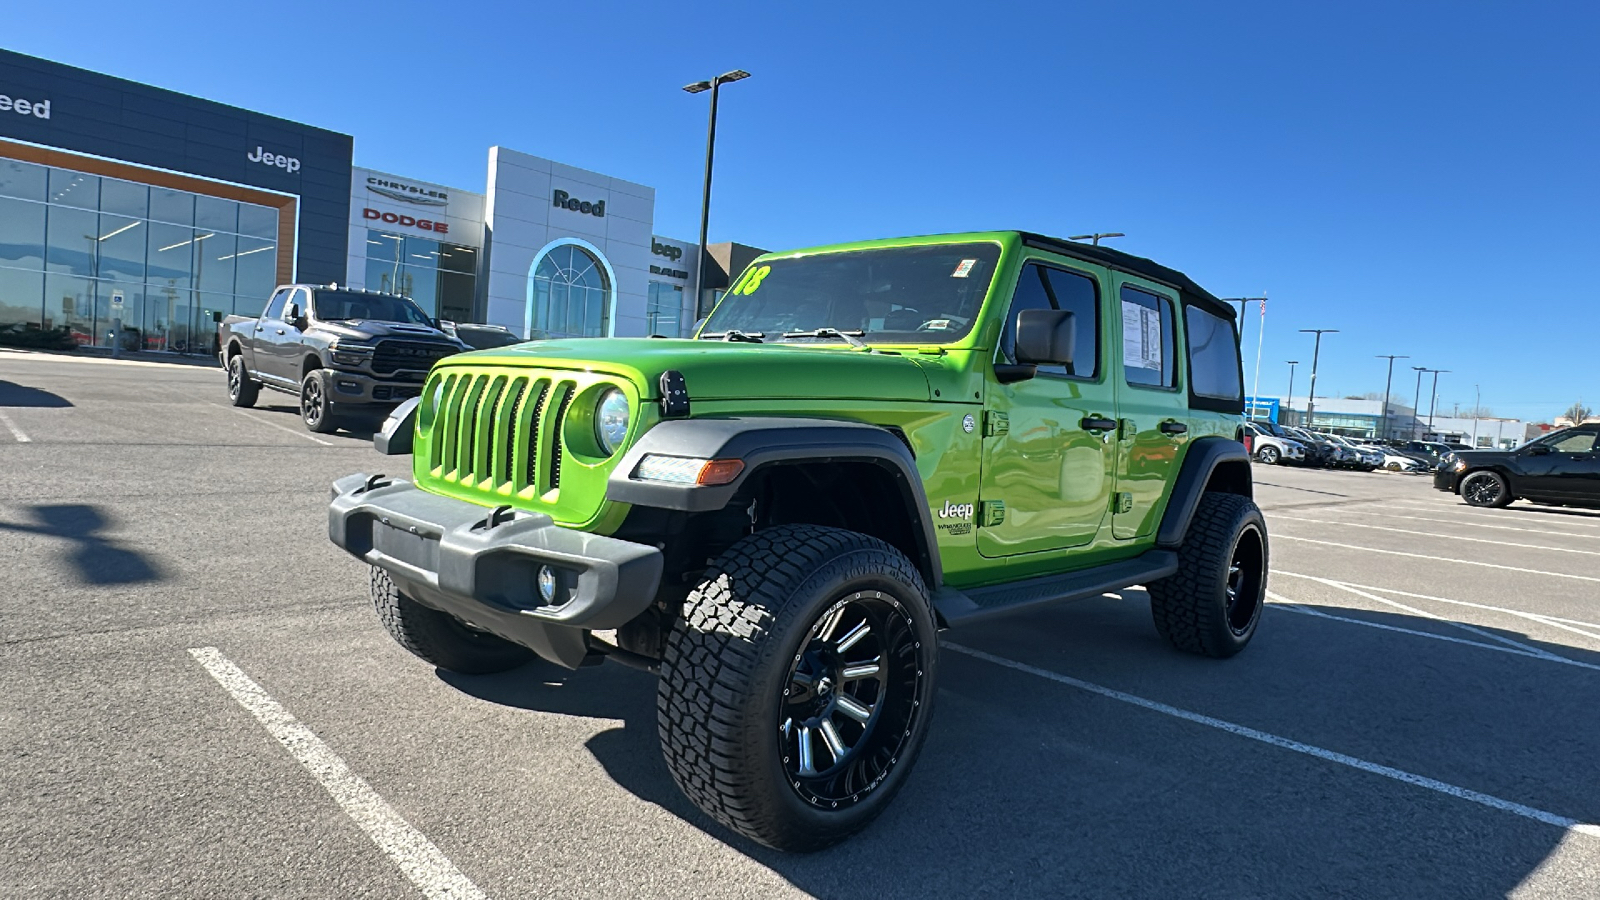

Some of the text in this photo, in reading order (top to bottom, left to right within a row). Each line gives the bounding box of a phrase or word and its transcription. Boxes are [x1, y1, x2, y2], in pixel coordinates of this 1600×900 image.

[0, 94, 51, 120] eed
[247, 146, 301, 173] Jeep
[366, 177, 448, 199] CHRYSLER
[553, 188, 606, 218] Reed
[363, 207, 449, 234] DODGE
[649, 264, 689, 280] RAM
[732, 265, 772, 296] 18
[938, 499, 974, 520] Jeep
